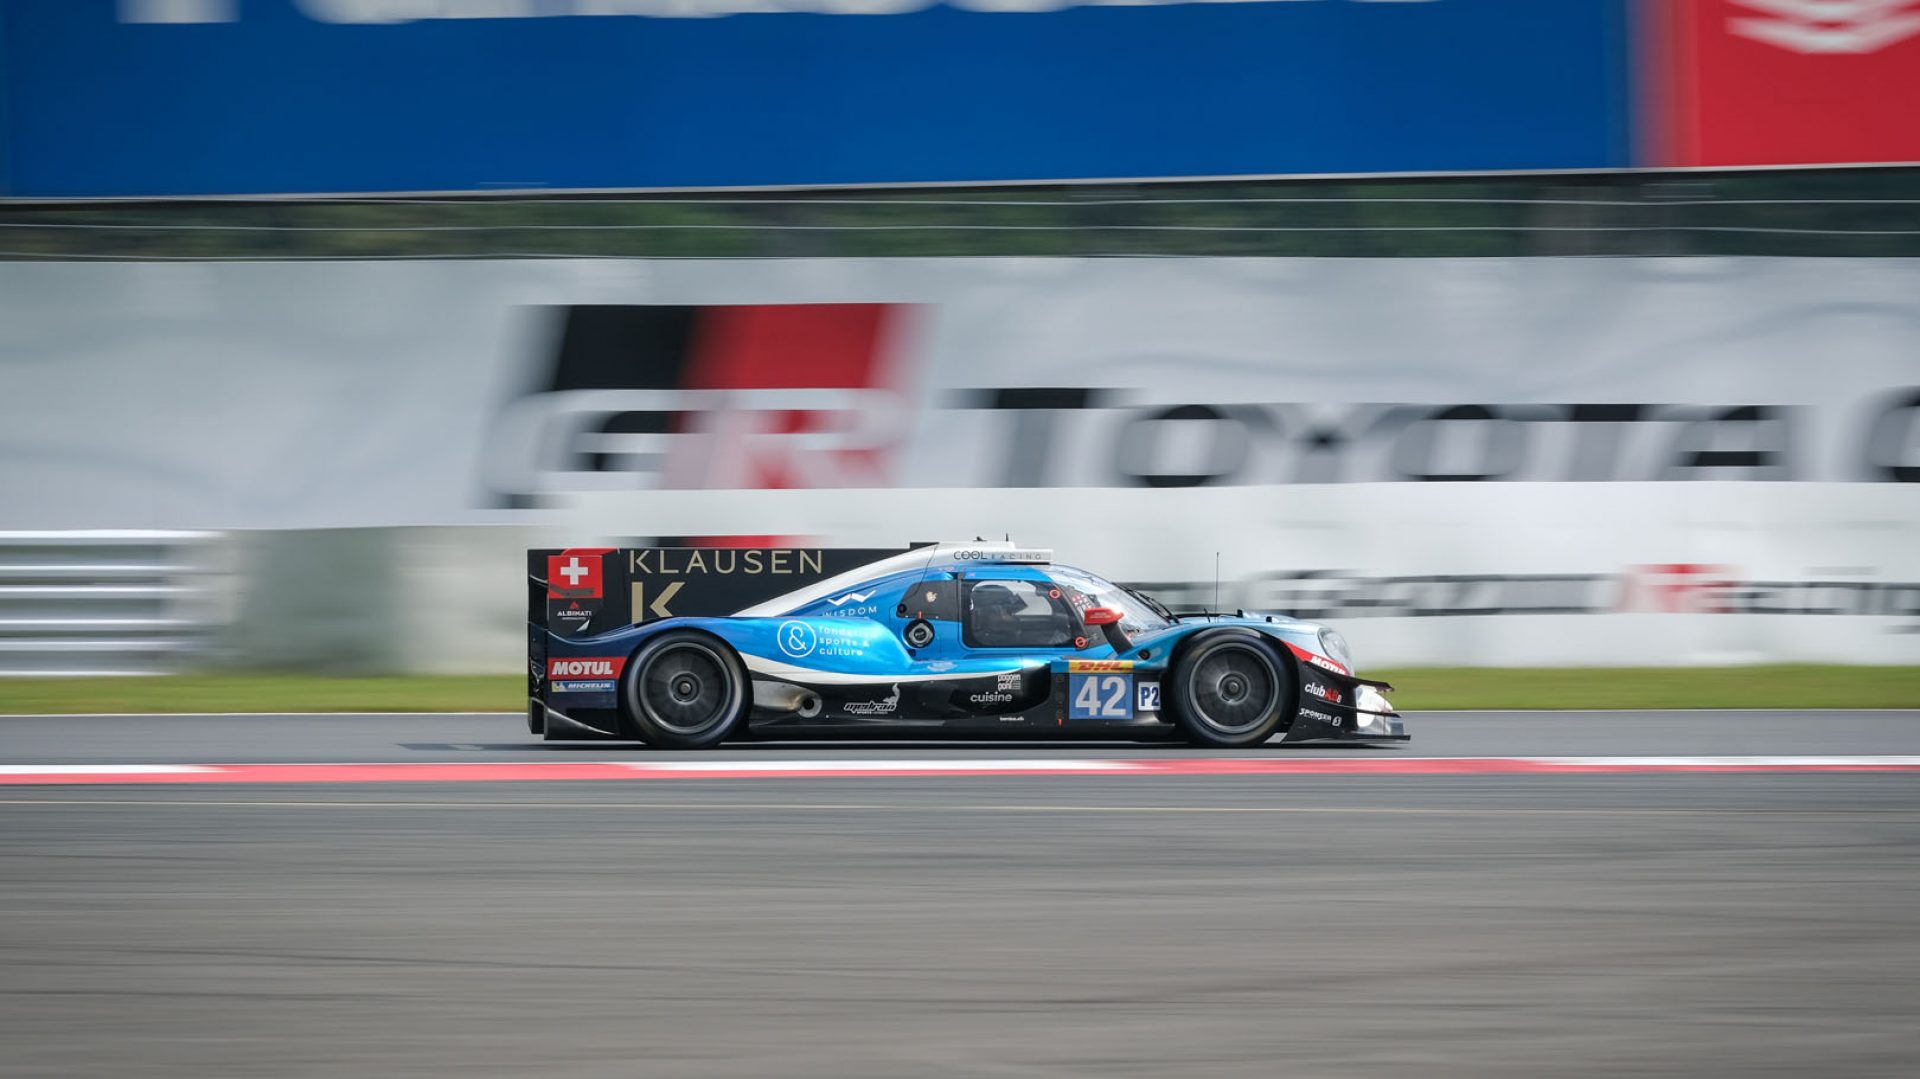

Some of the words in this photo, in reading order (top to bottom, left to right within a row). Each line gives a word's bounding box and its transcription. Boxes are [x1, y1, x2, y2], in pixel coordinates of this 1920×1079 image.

[948, 388, 1790, 485] TOYOTA
[629, 550, 822, 574] KLAUSEN
[953, 551, 988, 560] COOL
[819, 646, 863, 656] culture
[551, 661, 613, 675] MOTUL
[1078, 661, 1121, 671] DHL
[970, 691, 1012, 702] cuisine
[1075, 676, 1126, 716] 42
[1140, 686, 1160, 706] P2
